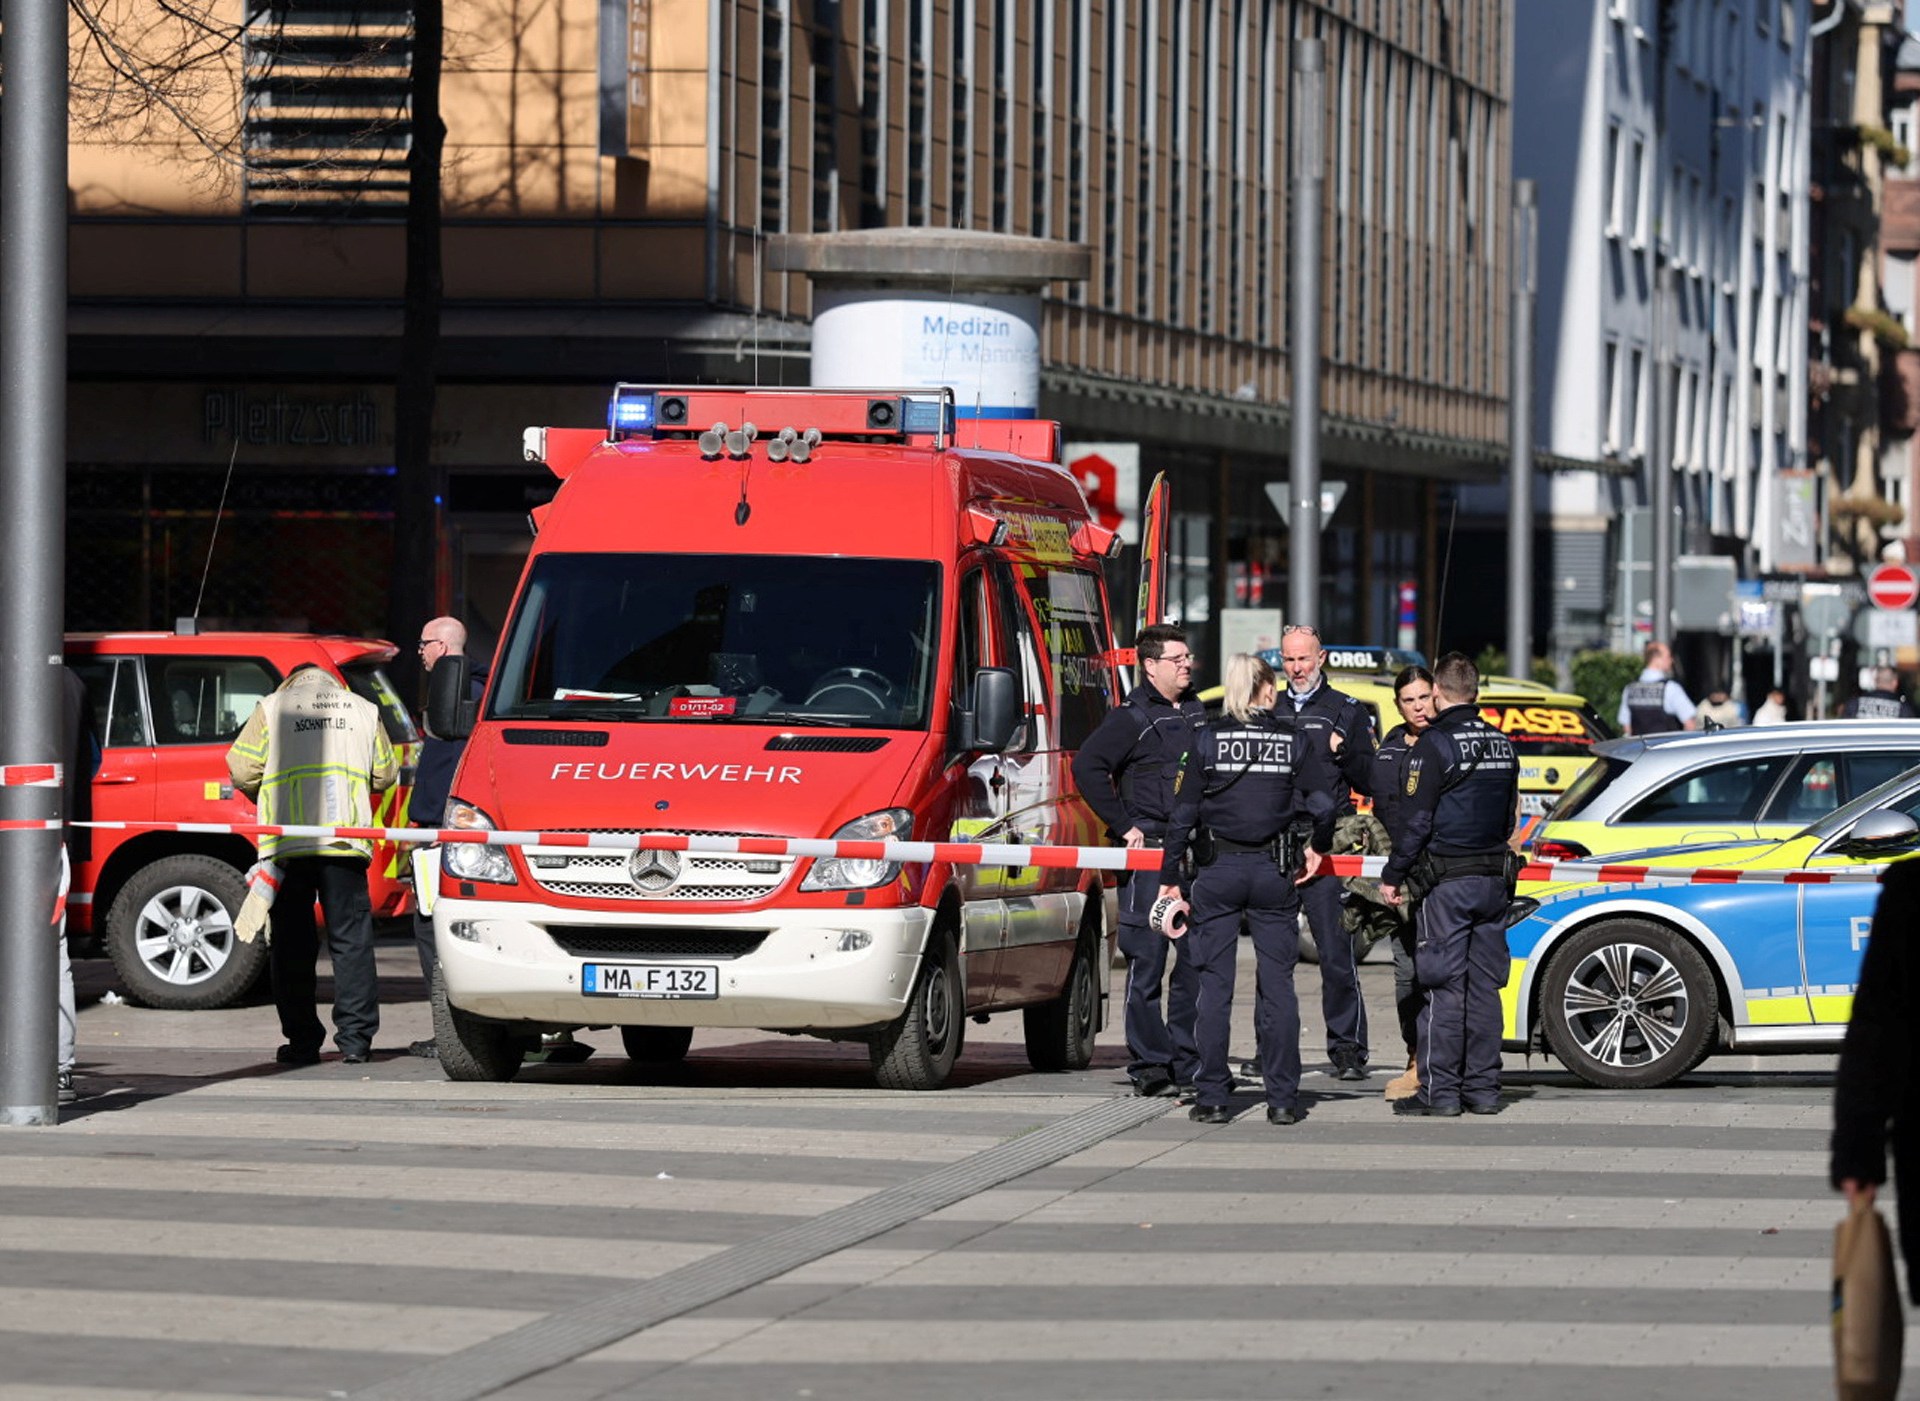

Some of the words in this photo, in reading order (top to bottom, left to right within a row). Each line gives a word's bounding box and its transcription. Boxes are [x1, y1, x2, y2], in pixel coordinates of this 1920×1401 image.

[923, 315, 1009, 337] Medizin
[1328, 652, 1378, 668] ORGL
[1500, 707, 1586, 736] ASB
[1217, 741, 1293, 764] POLIZEI
[550, 762, 804, 784] FEUERWEHR
[603, 968, 632, 990] MA
